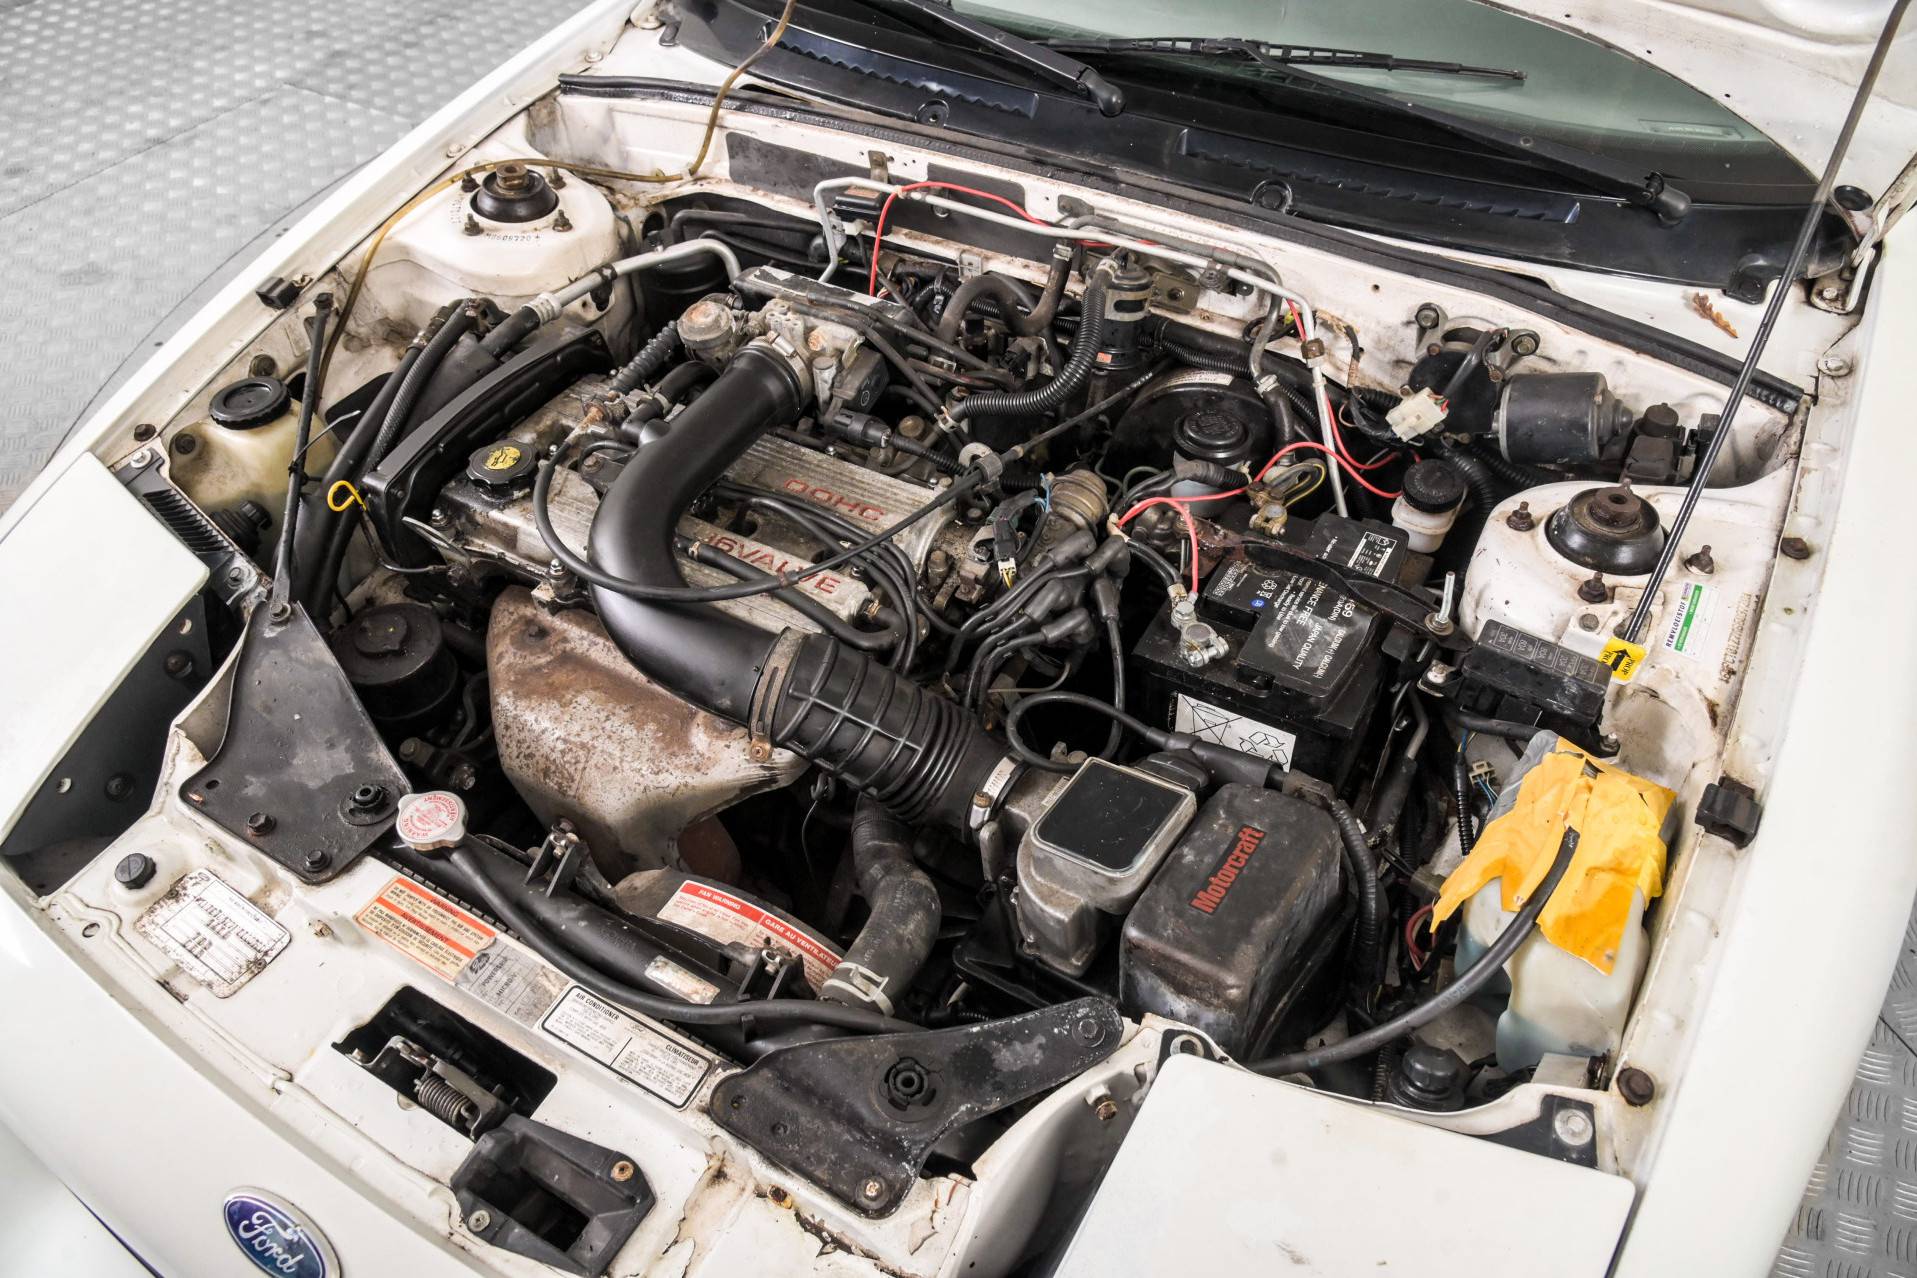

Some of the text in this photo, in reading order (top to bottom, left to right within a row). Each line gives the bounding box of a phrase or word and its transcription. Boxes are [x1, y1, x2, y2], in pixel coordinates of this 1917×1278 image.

[1307, 581, 1328, 606] ENANCE
[1296, 605, 1313, 626] FREE
[1292, 622, 1322, 670] JAPAN QUALITY
[1190, 826, 1265, 914] Motorcraft
[430, 898, 460, 917] WARNING
[400, 912, 450, 943] AVERTISSEMENT
[764, 918, 784, 933] GARE
[785, 929, 796, 941] AU
[575, 992, 620, 1020] AIR CONDITIONER
[665, 1044, 700, 1066] CLIMATISEUR
[238, 1211, 304, 1273] Ford
